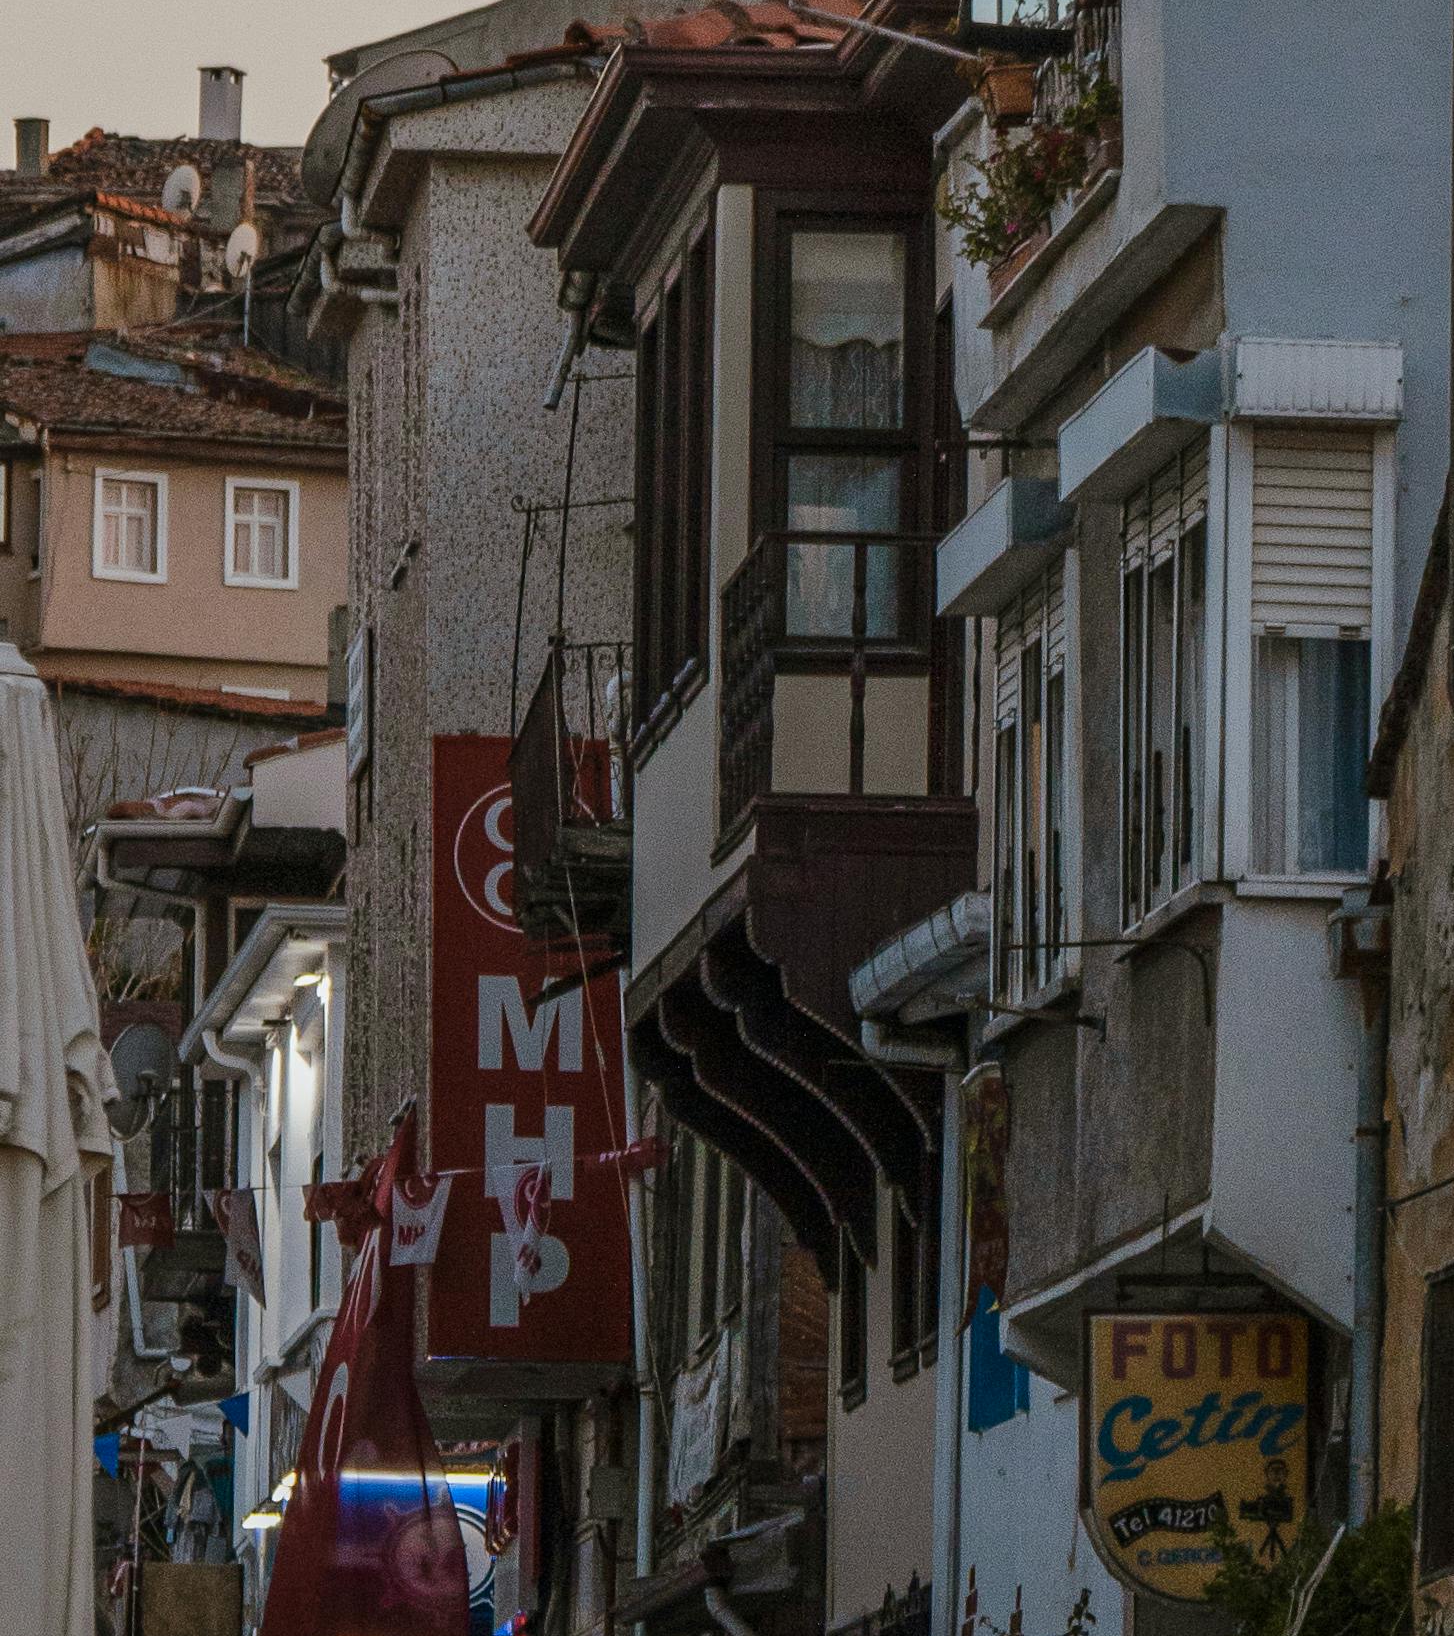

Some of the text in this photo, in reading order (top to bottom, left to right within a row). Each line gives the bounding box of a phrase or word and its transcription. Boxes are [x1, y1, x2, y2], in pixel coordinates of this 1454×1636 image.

[478, 975, 583, 1327] MHP
[1112, 1322, 1292, 1380] FOTO
[1098, 1391, 1307, 1482] Çetin
[1114, 1508, 1151, 1538] Tel
